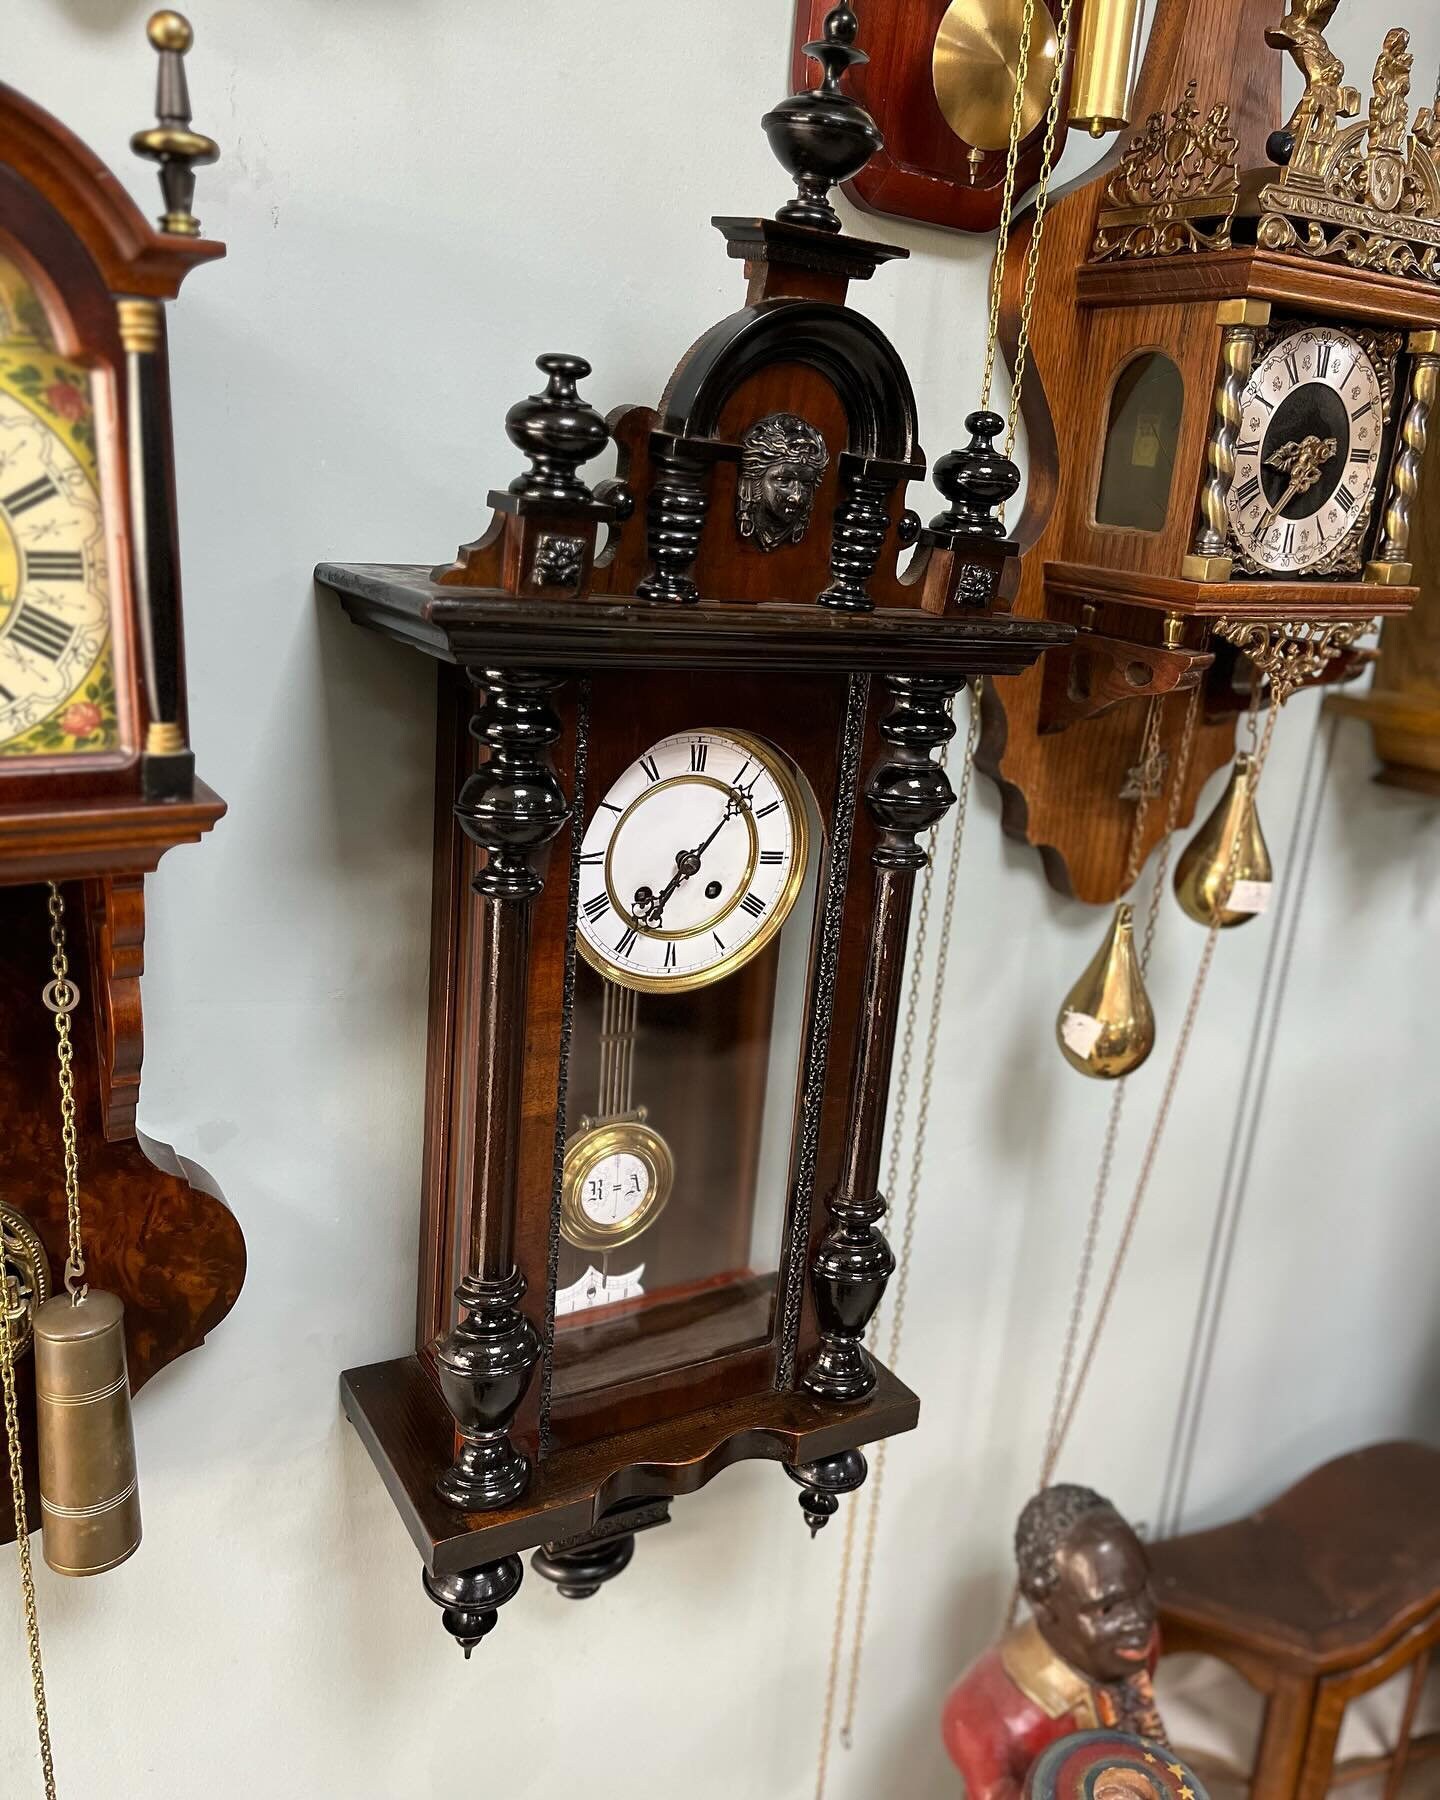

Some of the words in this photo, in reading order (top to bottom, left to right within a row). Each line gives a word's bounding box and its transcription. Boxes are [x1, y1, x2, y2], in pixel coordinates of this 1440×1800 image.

[1321, 331, 1332, 341] 60
[1284, 353, 1300, 390] XI
[1312, 345, 1332, 379] XII
[1351, 400, 1372, 423] II
[1350, 448, 1371, 464] III
[2, 472, 60, 518] II
[1237, 474, 1261, 511] VIII
[1333, 483, 1356, 513] IIII
[1283, 523, 1296, 554] VI
[25, 550, 85, 581] III
[6, 602, 76, 662] IIII
[639, 754, 660, 787] XI
[685, 744, 708, 772] XII
[732, 761, 750, 785] I
[755, 800, 780, 820] II
[759, 850, 784, 865] III
[583, 891, 611, 925] VIII
[740, 891, 767, 919] IIII
[614, 926, 639, 959] VII
[663, 941, 676, 968] VI
[712, 930, 726, 954] V
